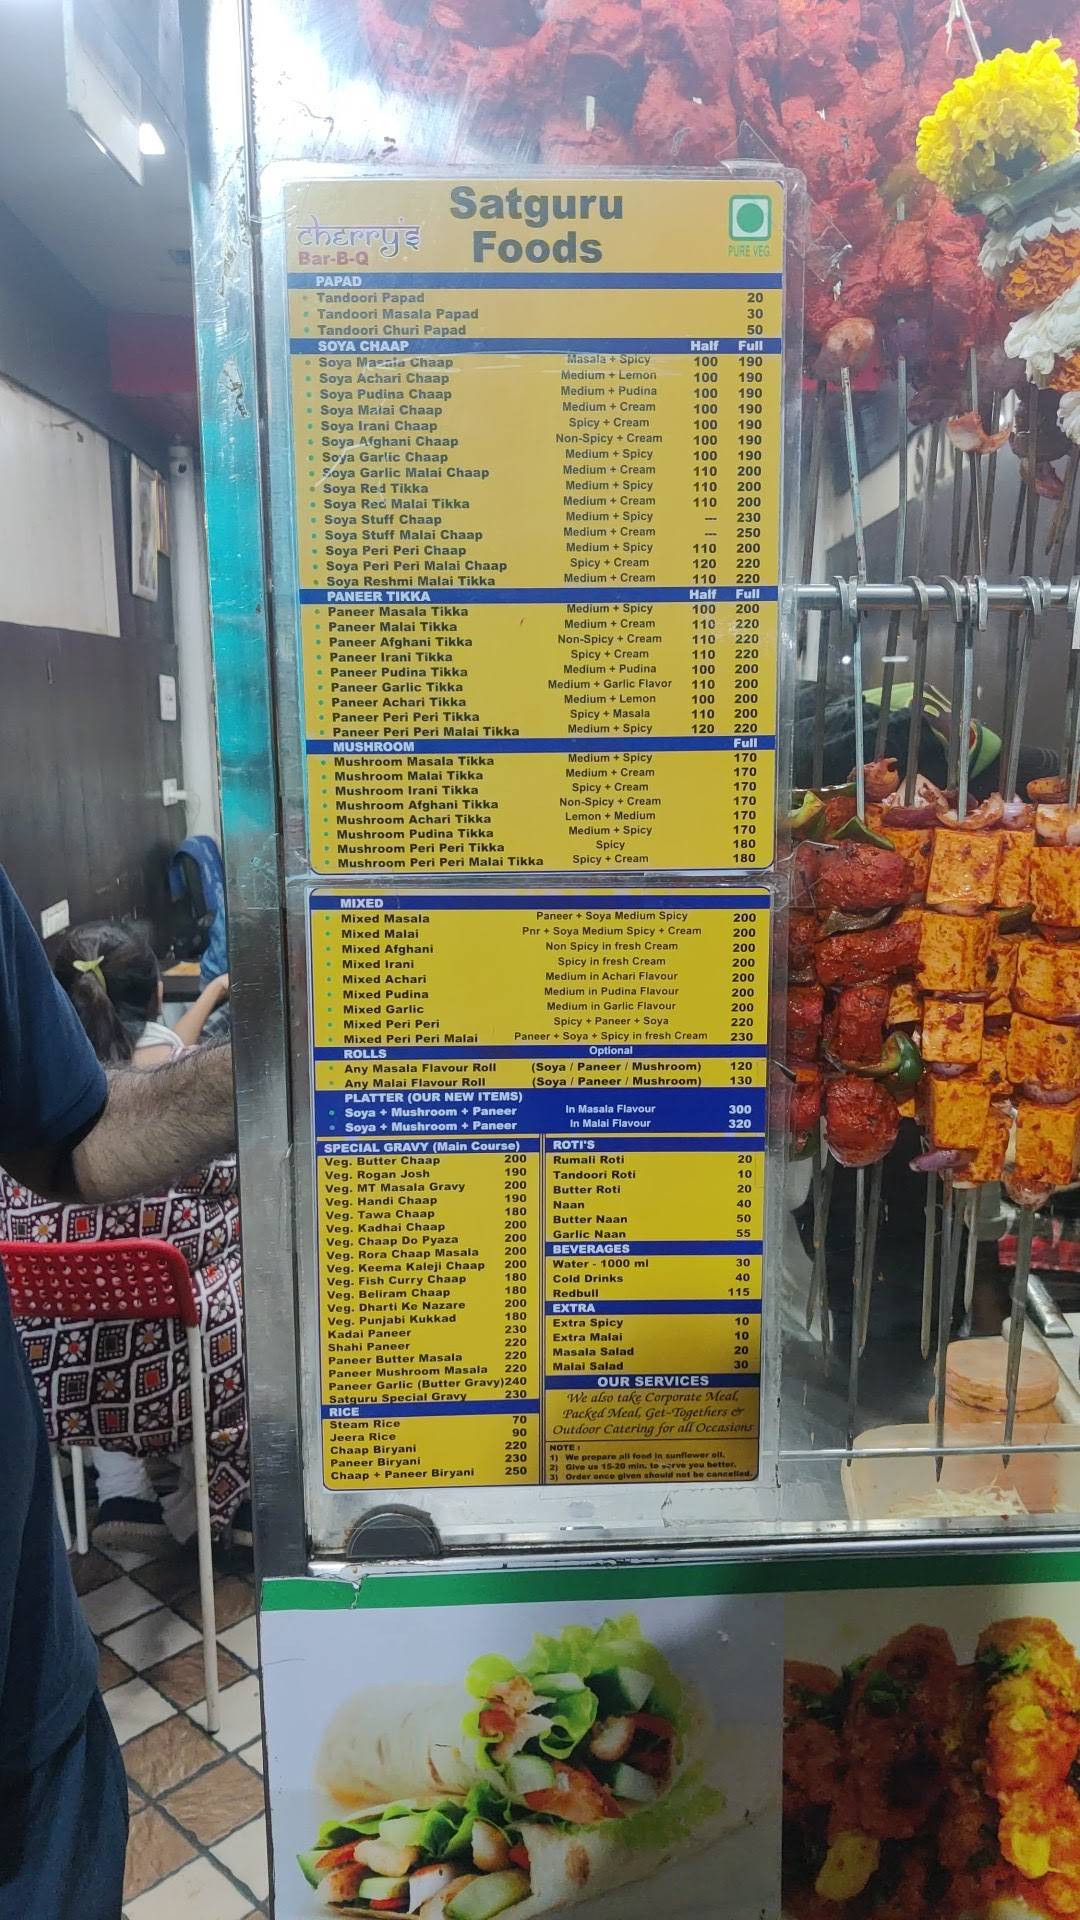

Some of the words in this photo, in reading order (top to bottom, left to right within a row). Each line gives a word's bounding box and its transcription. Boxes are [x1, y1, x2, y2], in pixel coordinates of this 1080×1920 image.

[450, 186, 623, 228] Satguru
[474, 231, 602, 263] Foods
[728, 245, 750, 256] PURE
[299, 252, 368, 266] Bar-B-Q
[316, 276, 362, 286] PAPAD
[316, 292, 377, 303] Tandoori
[382, 293, 424, 305] Papad
[747, 293, 763, 302] 20
[317, 309, 377, 319] Tandoori
[382, 309, 431, 319] Masala
[436, 308, 478, 322] Papad
[748, 309, 763, 319] 30
[317, 325, 378, 335] Tandoori
[383, 325, 419, 335] Churi
[424, 325, 466, 337] Papad
[747, 325, 763, 334] 50
[318, 341, 356, 351] SOYA
[360, 341, 409, 351] CHAAP
[691, 340, 719, 350] Half
[739, 341, 762, 350] Full
[320, 373, 352, 386] Soya
[357, 373, 401, 383] Achari
[406, 373, 449, 385] Chaap
[561, 369, 605, 380] Medium
[619, 370, 656, 380] Lemon
[694, 372, 717, 382] 100
[739, 372, 762, 382] 190
[321, 421, 353, 433] Soya
[359, 421, 389, 431] Irani
[395, 420, 437, 433] Chaap
[569, 418, 600, 429] Spicy
[614, 418, 649, 427] Cream
[694, 420, 717, 430] 100
[738, 420, 762, 430] 190
[326, 561, 358, 573] Soya
[364, 561, 388, 570] Peri
[394, 561, 419, 570] Peri
[424, 561, 460, 570] Malai
[465, 561, 507, 572] Chaap
[570, 558, 600, 569] Spicy
[614, 558, 649, 567] Cream
[693, 559, 716, 568] 120
[736, 559, 760, 568] 220
[328, 591, 382, 601] PANEER
[386, 591, 430, 601] TIKKA
[690, 590, 716, 600] Half
[736, 589, 760, 599] Full
[330, 637, 376, 647] Paneer
[380, 637, 430, 649] Afghani
[435, 637, 472, 646] Tikka
[558, 634, 613, 646] Non-Spicy
[627, 634, 661, 643] Cream
[692, 634, 715, 644] 110
[736, 634, 758, 644] 220
[332, 683, 377, 692] Paneer
[382, 682, 421, 692] Garlic
[426, 682, 463, 692] Tikka
[548, 680, 590, 688] Medium
[604, 679, 635, 688] Garlic
[639, 679, 672, 688] Flavor
[692, 680, 715, 689] 110
[735, 679, 758, 688] 200
[334, 742, 414, 752] MUSHROOM
[734, 738, 757, 748] Full
[336, 786, 403, 795] Mushroom
[408, 786, 437, 795] Irani
[442, 786, 478, 794] Tikka
[572, 783, 601, 794] Spicy
[614, 783, 648, 791] Cream
[734, 782, 756, 791] 170
[341, 899, 383, 908] MIXED
[342, 914, 379, 923] Mixed
[384, 914, 429, 923] Masala
[537, 912, 572, 920] Paneer
[586, 912, 611, 922] Soya
[615, 912, 655, 920] Medium
[659, 912, 687, 922] Spicy
[734, 913, 756, 922] 200
[344, 1005, 381, 1014] Mixed
[386, 1005, 424, 1013] Garlic
[547, 1002, 587, 1010] Medium
[591, 1002, 600, 1010] in
[604, 1002, 634, 1010] Garlic
[638, 1002, 676, 1010] Flavour
[731, 1003, 753, 1012] 200
[344, 1050, 387, 1059] ROLLS
[589, 1046, 632, 1056] Optional
[345, 1080, 368, 1089] Any
[373, 1079, 407, 1087] Malai
[411, 1078, 457, 1087] Flavour
[462, 1078, 485, 1086] Roll
[532, 1077, 567, 1087] (Soya
[578, 1078, 621, 1086] Paneer
[633, 1077, 701, 1086] Mushroom)
[730, 1076, 752, 1084] 130
[345, 1094, 403, 1103] PLATTER
[408, 1093, 440, 1104] (OUR
[445, 1092, 474, 1101] NEW
[479, 1092, 522, 1103] ITEMS)
[324, 1144, 380, 1153] SPECIAL
[384, 1143, 429, 1152] GRAVY
[433, 1142, 469, 1152] (Main
[472, 1141, 520, 1152] Course)
[554, 1140, 594, 1149] ROTI'S
[325, 1171, 352, 1182] Veg.
[358, 1171, 396, 1181] Rogan
[401, 1169, 430, 1178] Josh
[505, 1168, 526, 1176] 190
[553, 1171, 606, 1179] Tandoori
[612, 1170, 635, 1178] Roti
[738, 1170, 752, 1178] 10
[553, 1244, 630, 1254] BEVERAGES
[553, 1275, 580, 1283] Cold
[585, 1274, 623, 1282] Drinks
[736, 1273, 750, 1281] 40
[553, 1304, 595, 1312] EXTRA
[553, 1319, 585, 1327] Extra
[590, 1318, 623, 1328] Spicy
[736, 1317, 749, 1325] 10
[598, 1377, 629, 1386] OUR
[635, 1376, 709, 1386] SERVICES
[567, 1392, 587, 1403] We
[591, 1392, 613, 1403] also
[618, 1391, 642, 1405] take
[645, 1393, 702, 1405] Corporate
[705, 1391, 739, 1402] Meal,
[330, 1408, 359, 1416] RICE
[330, 1446, 369, 1456] Chaap
[374, 1445, 416, 1455] Biryani
[505, 1441, 526, 1450] 220
